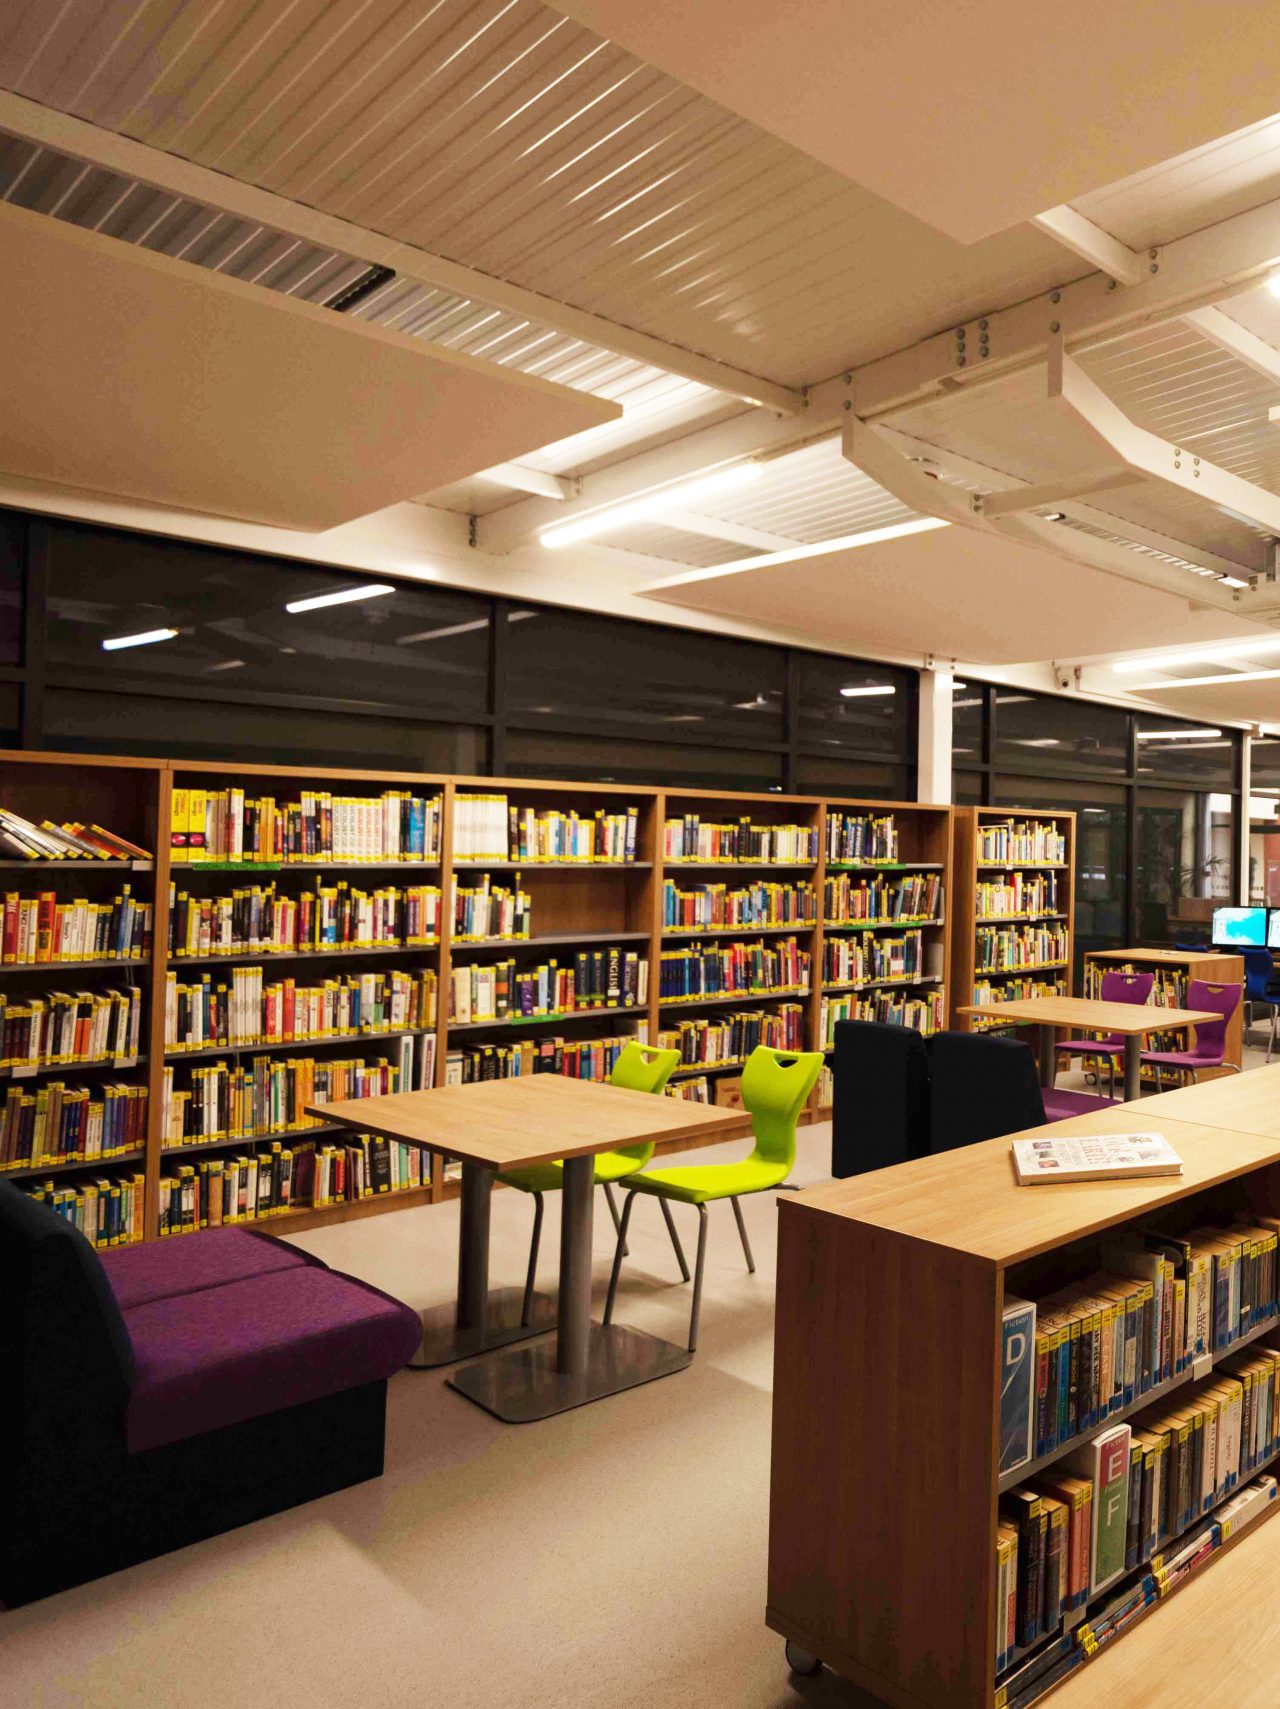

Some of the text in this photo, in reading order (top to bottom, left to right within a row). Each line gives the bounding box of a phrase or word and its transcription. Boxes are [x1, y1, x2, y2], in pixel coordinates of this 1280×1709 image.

[609, 957, 619, 990] NGLIS
[1004, 1315, 1029, 1329] Fiction
[1006, 1332, 1026, 1366] D
[1105, 1435, 1127, 1449] Fiction
[1108, 1449, 1124, 1482] E
[1107, 1493, 1121, 1527] F
